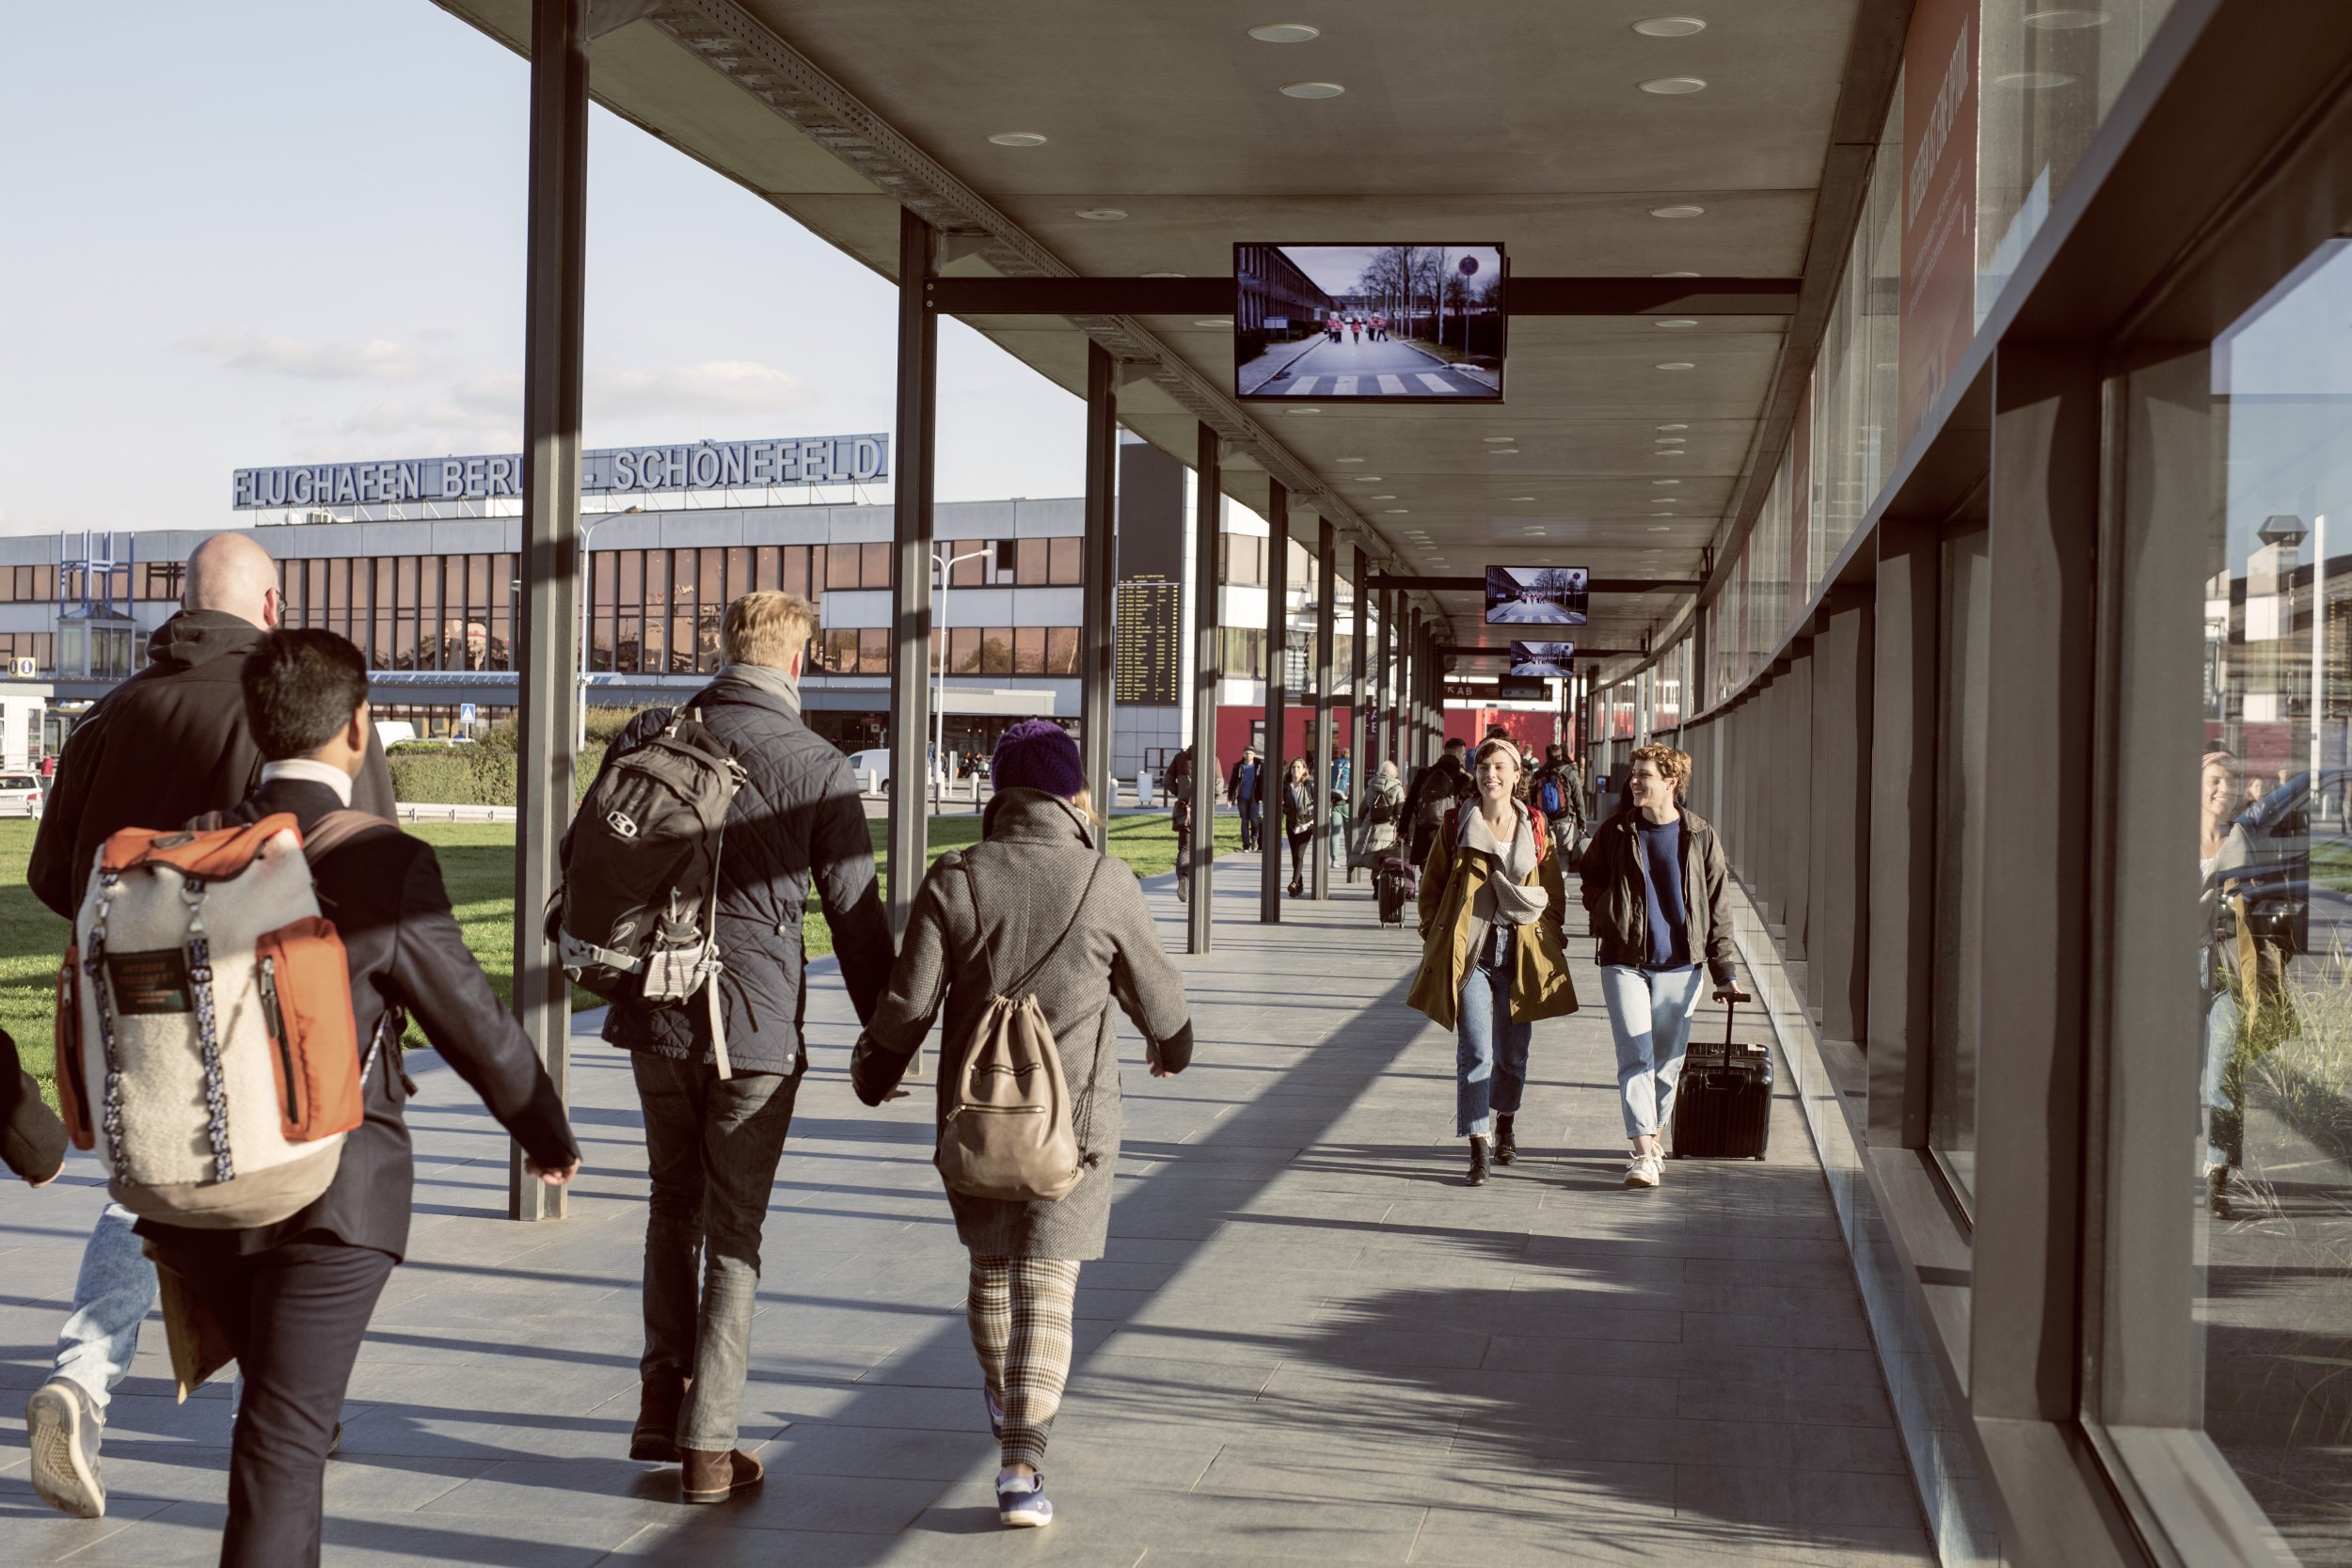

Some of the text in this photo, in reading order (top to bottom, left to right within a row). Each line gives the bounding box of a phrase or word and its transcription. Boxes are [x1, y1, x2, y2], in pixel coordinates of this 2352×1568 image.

[235, 462, 421, 506] FLUGHAFEN
[442, 457, 523, 499] BERL
[613, 438, 882, 490] SCHÖNEFELD
